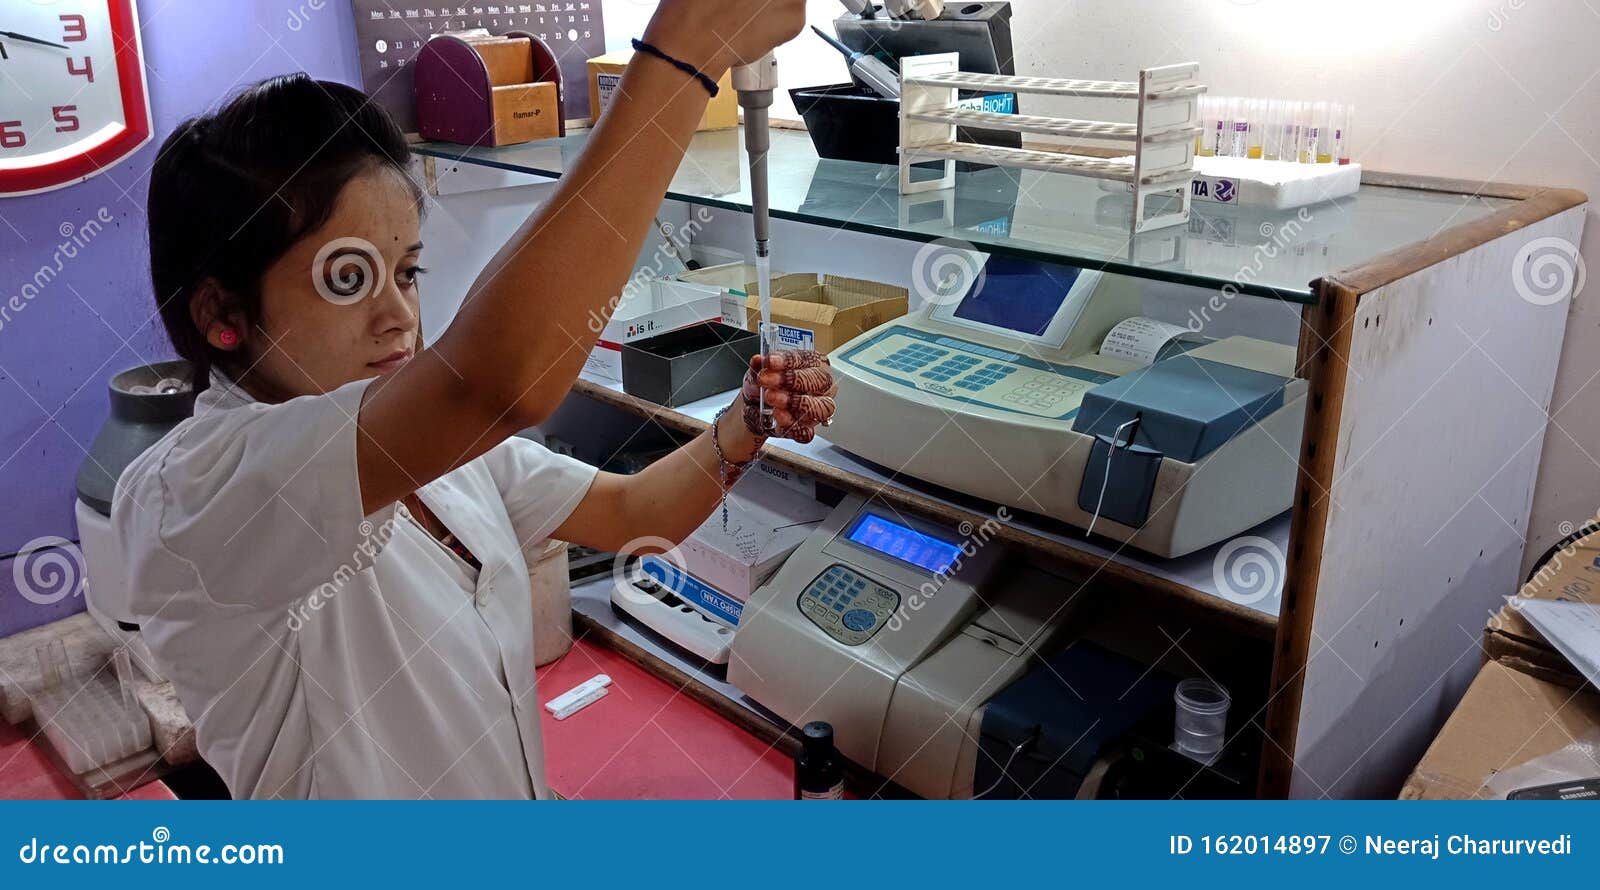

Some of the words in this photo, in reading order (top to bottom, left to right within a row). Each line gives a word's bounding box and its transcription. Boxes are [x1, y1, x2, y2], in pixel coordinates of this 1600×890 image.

[406, 9, 418, 17] Wed
[59, 14, 87, 42] 3
[66, 56, 94, 83] 4
[52, 105, 80, 133] 5
[0, 120, 26, 148] 6
[1560, 790, 1598, 800] SAMSUNG
